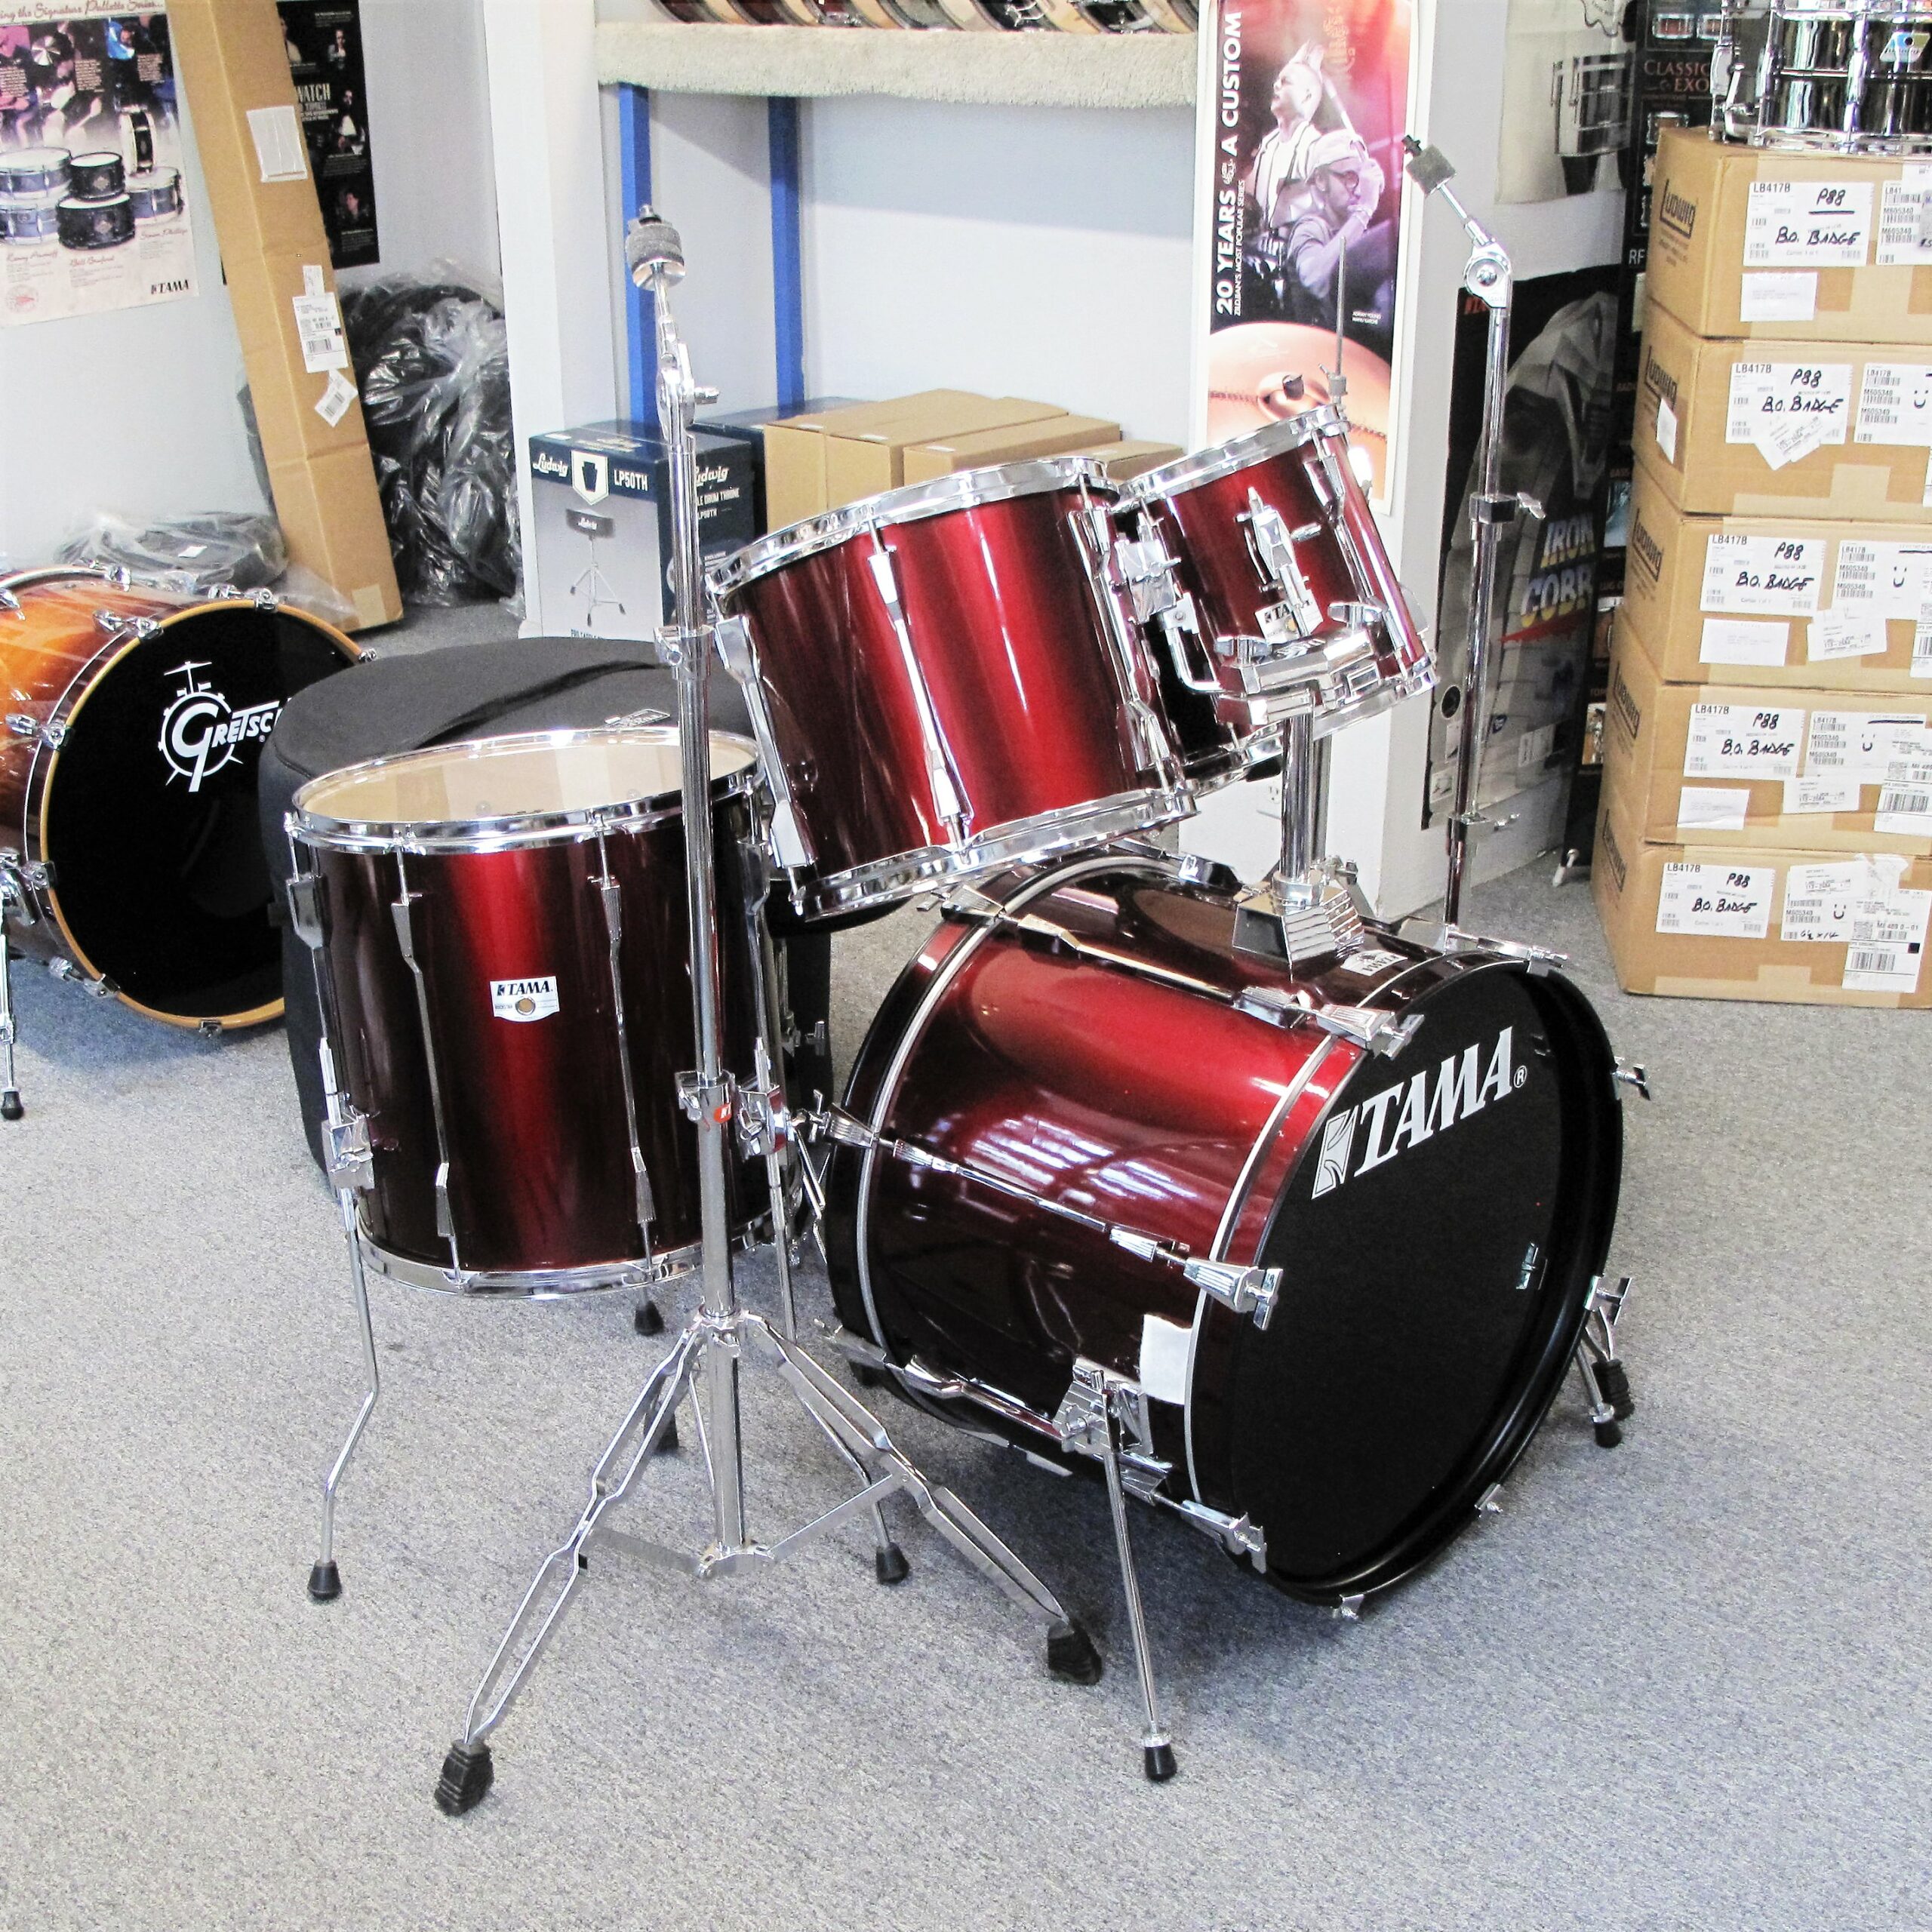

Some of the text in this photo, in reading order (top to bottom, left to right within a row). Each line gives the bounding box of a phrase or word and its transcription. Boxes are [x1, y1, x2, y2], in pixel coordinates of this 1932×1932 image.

[1216, 11, 1242, 315] 20 YEARS A CUSTOM
[1753, 183, 1791, 193] LB417B
[1816, 188, 1846, 206] P88
[1235, 208, 1244, 247] POPULAR
[1807, 229, 1861, 246] BADGE
[1235, 248, 1243, 272] MOST
[158, 279, 189, 294] TAMA
[1735, 364, 1772, 374] LB417B
[1790, 368, 1823, 389] P88
[1789, 395, 1844, 414] BADGE
[532, 453, 568, 478] Ludwig
[614, 469, 649, 491] LP50TH
[1540, 512, 1595, 568] IRON
[1712, 535, 1747, 545] LB417B
[1774, 542, 1804, 561] P88
[1764, 574, 1815, 592] BADGE
[1521, 562, 1594, 628] COBR
[1695, 705, 1730, 715] LB417B
[1752, 712, 1780, 730] P88
[1667, 864, 1701, 873] LB417B
[1726, 872, 1751, 888] P88
[507, 980, 550, 996] TAMA
[1353, 1026, 1513, 1178] TAMA
